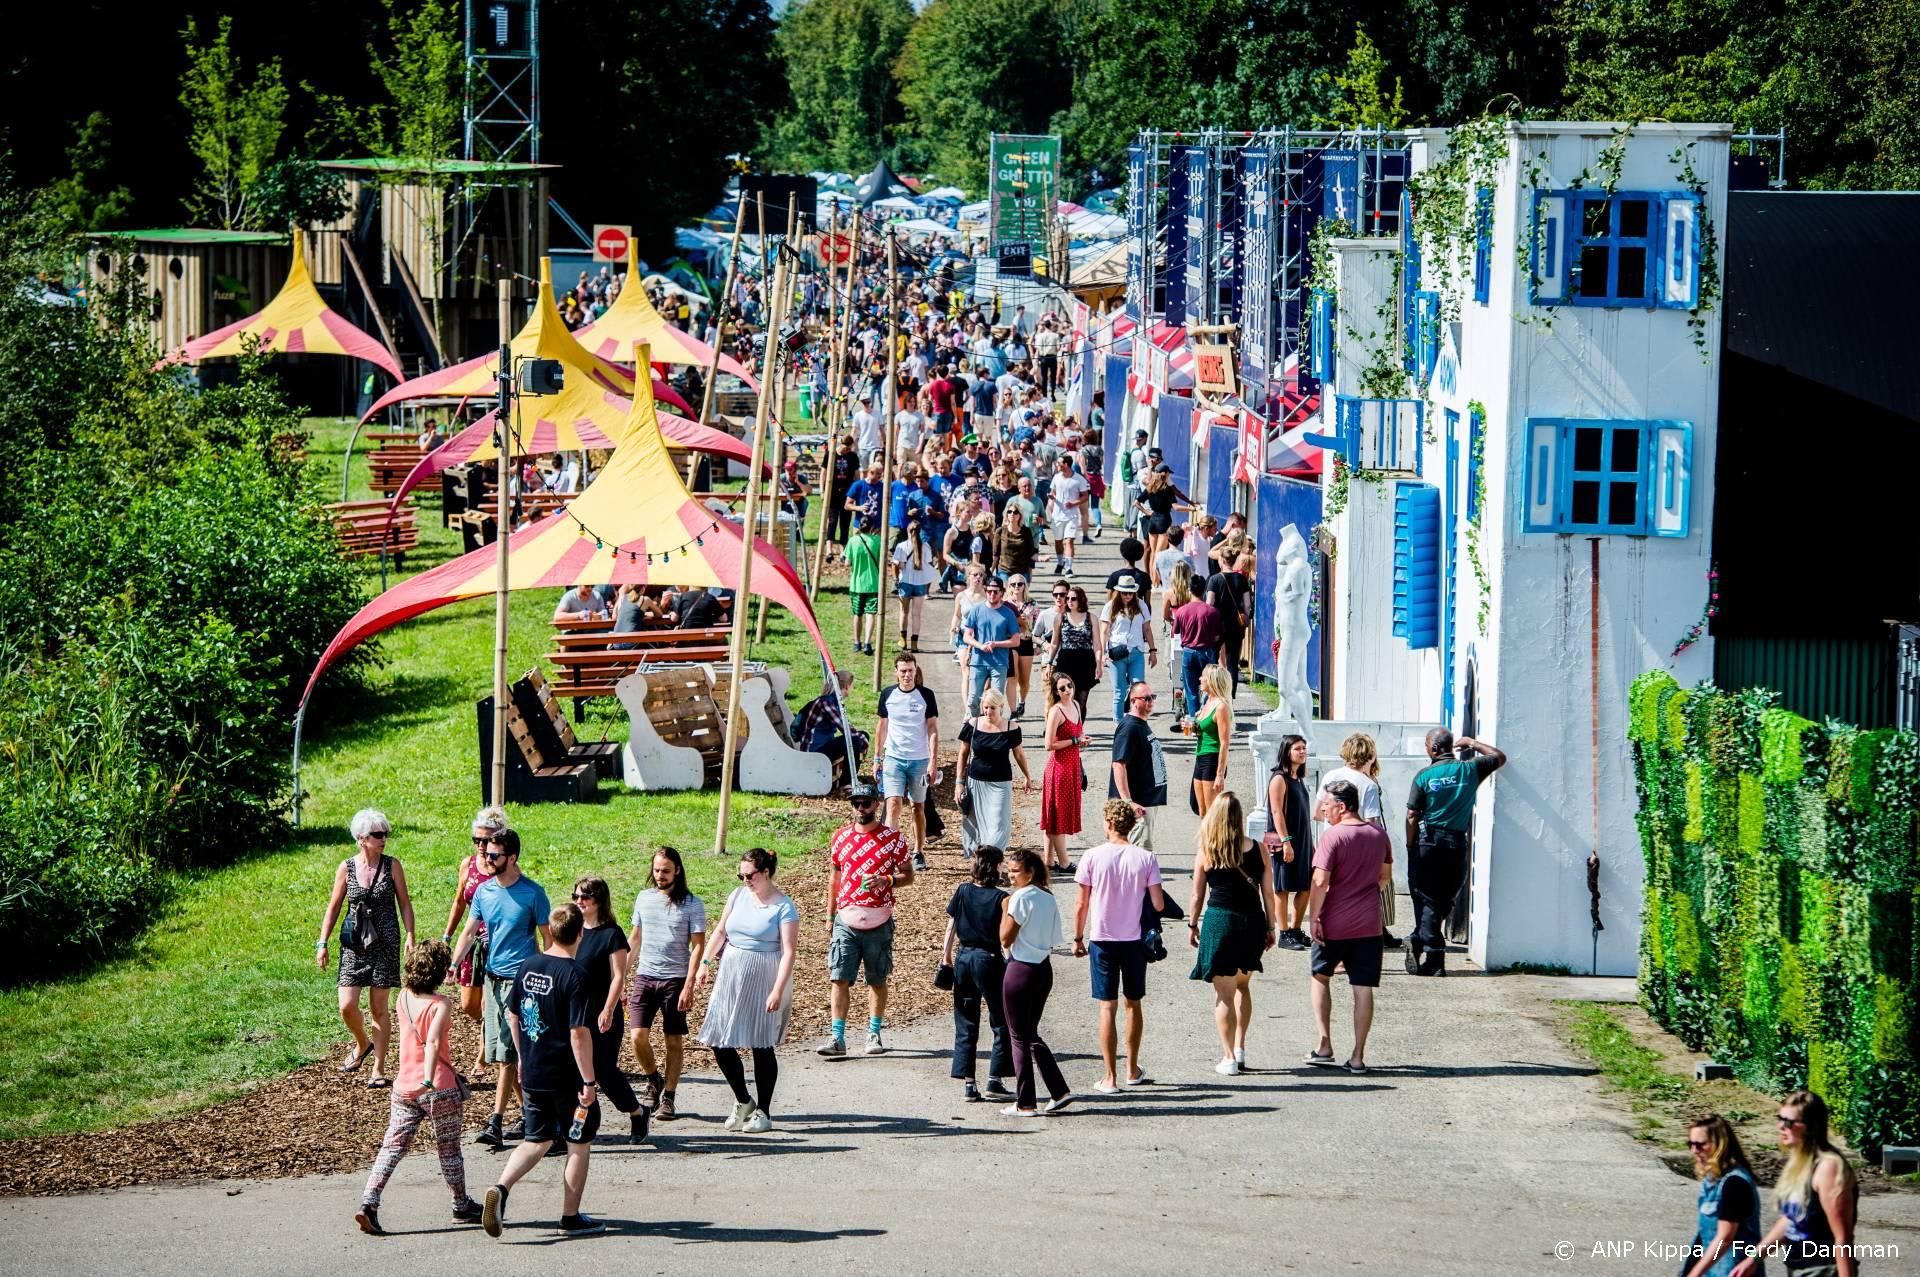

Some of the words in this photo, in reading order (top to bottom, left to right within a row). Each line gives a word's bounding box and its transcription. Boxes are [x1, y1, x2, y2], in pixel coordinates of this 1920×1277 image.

[1004, 246, 1025, 255] EXIT
[1440, 776, 1457, 785] TSC
[851, 838, 877, 862] FEBO
[851, 857, 876, 881] FEBO
